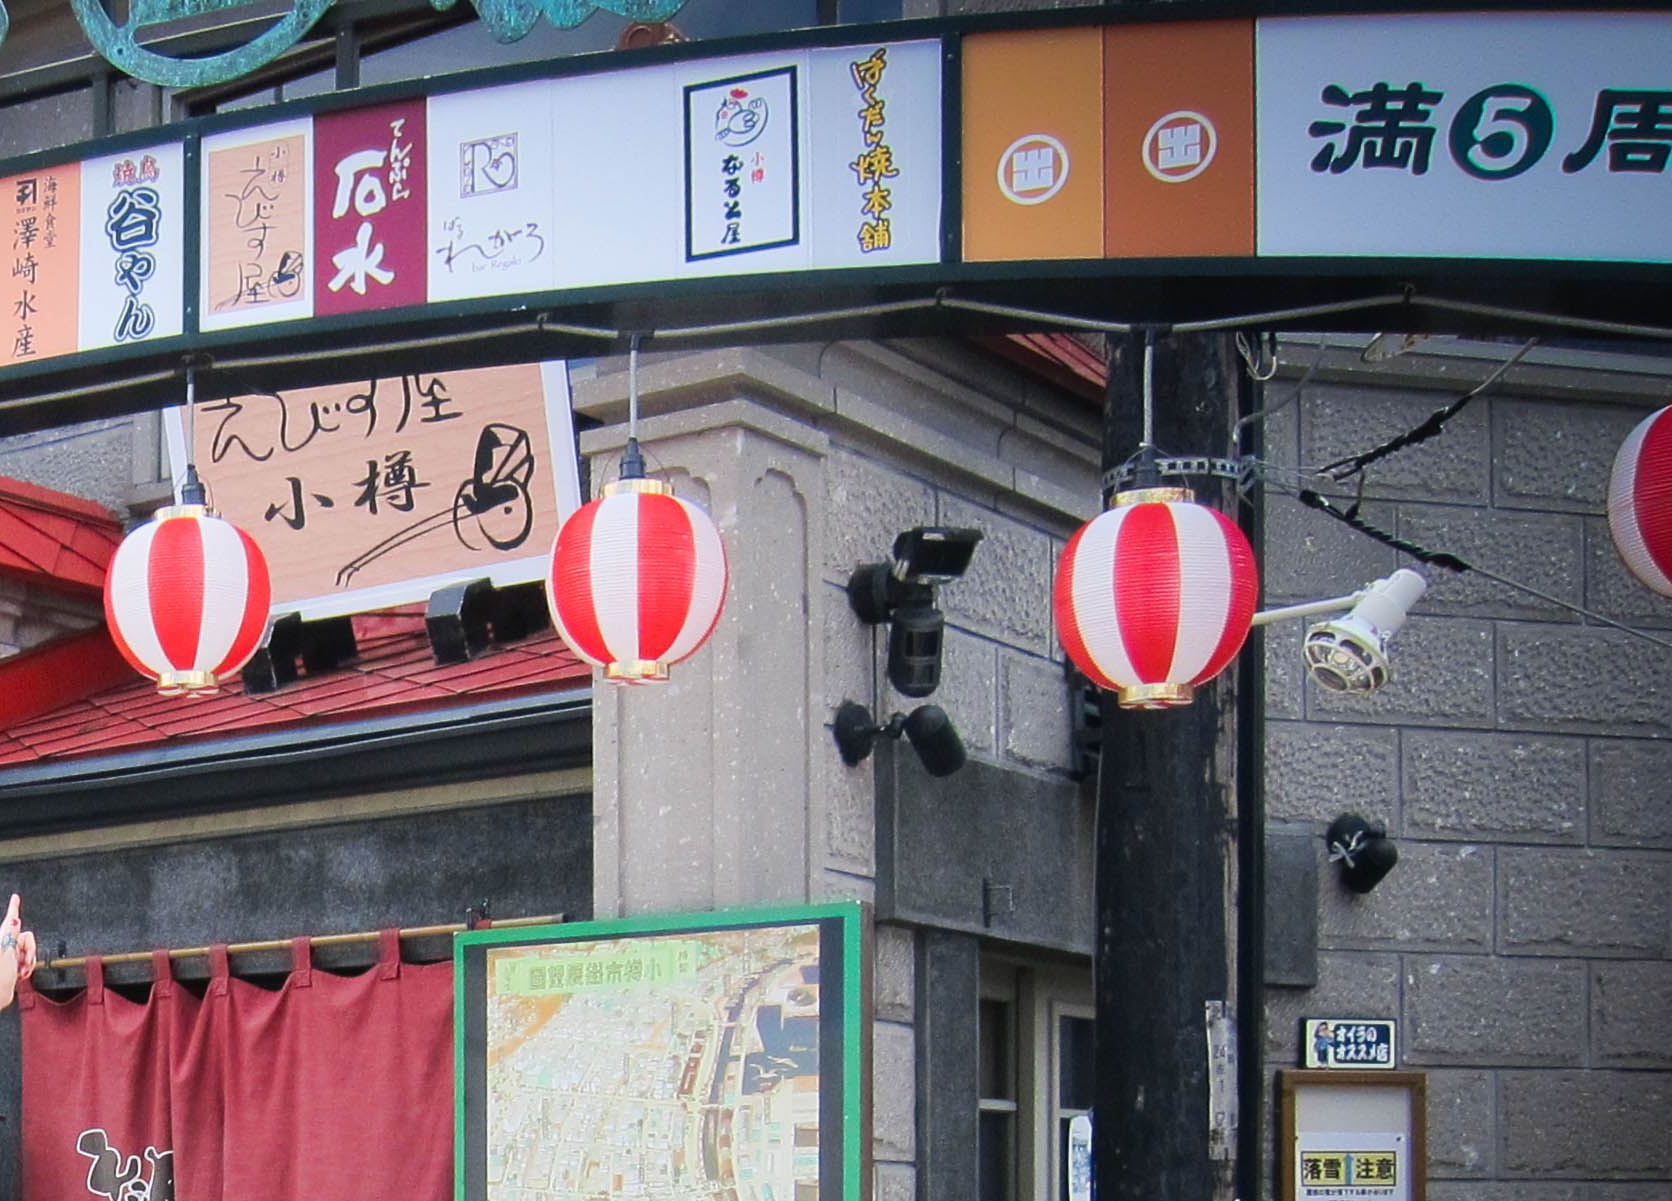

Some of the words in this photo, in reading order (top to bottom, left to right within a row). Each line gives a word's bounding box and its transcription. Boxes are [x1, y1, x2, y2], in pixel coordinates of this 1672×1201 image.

[42, 175, 58, 249] 海鮮食堂
[105, 187, 162, 342] 谷やん
[328, 150, 395, 295] 石水
[12, 216, 39, 358] 澤崎水産
[264, 451, 431, 530] 小樽
[1303, 1158, 1341, 1180] 落雪
[1356, 1158, 1395, 1180] 注意
